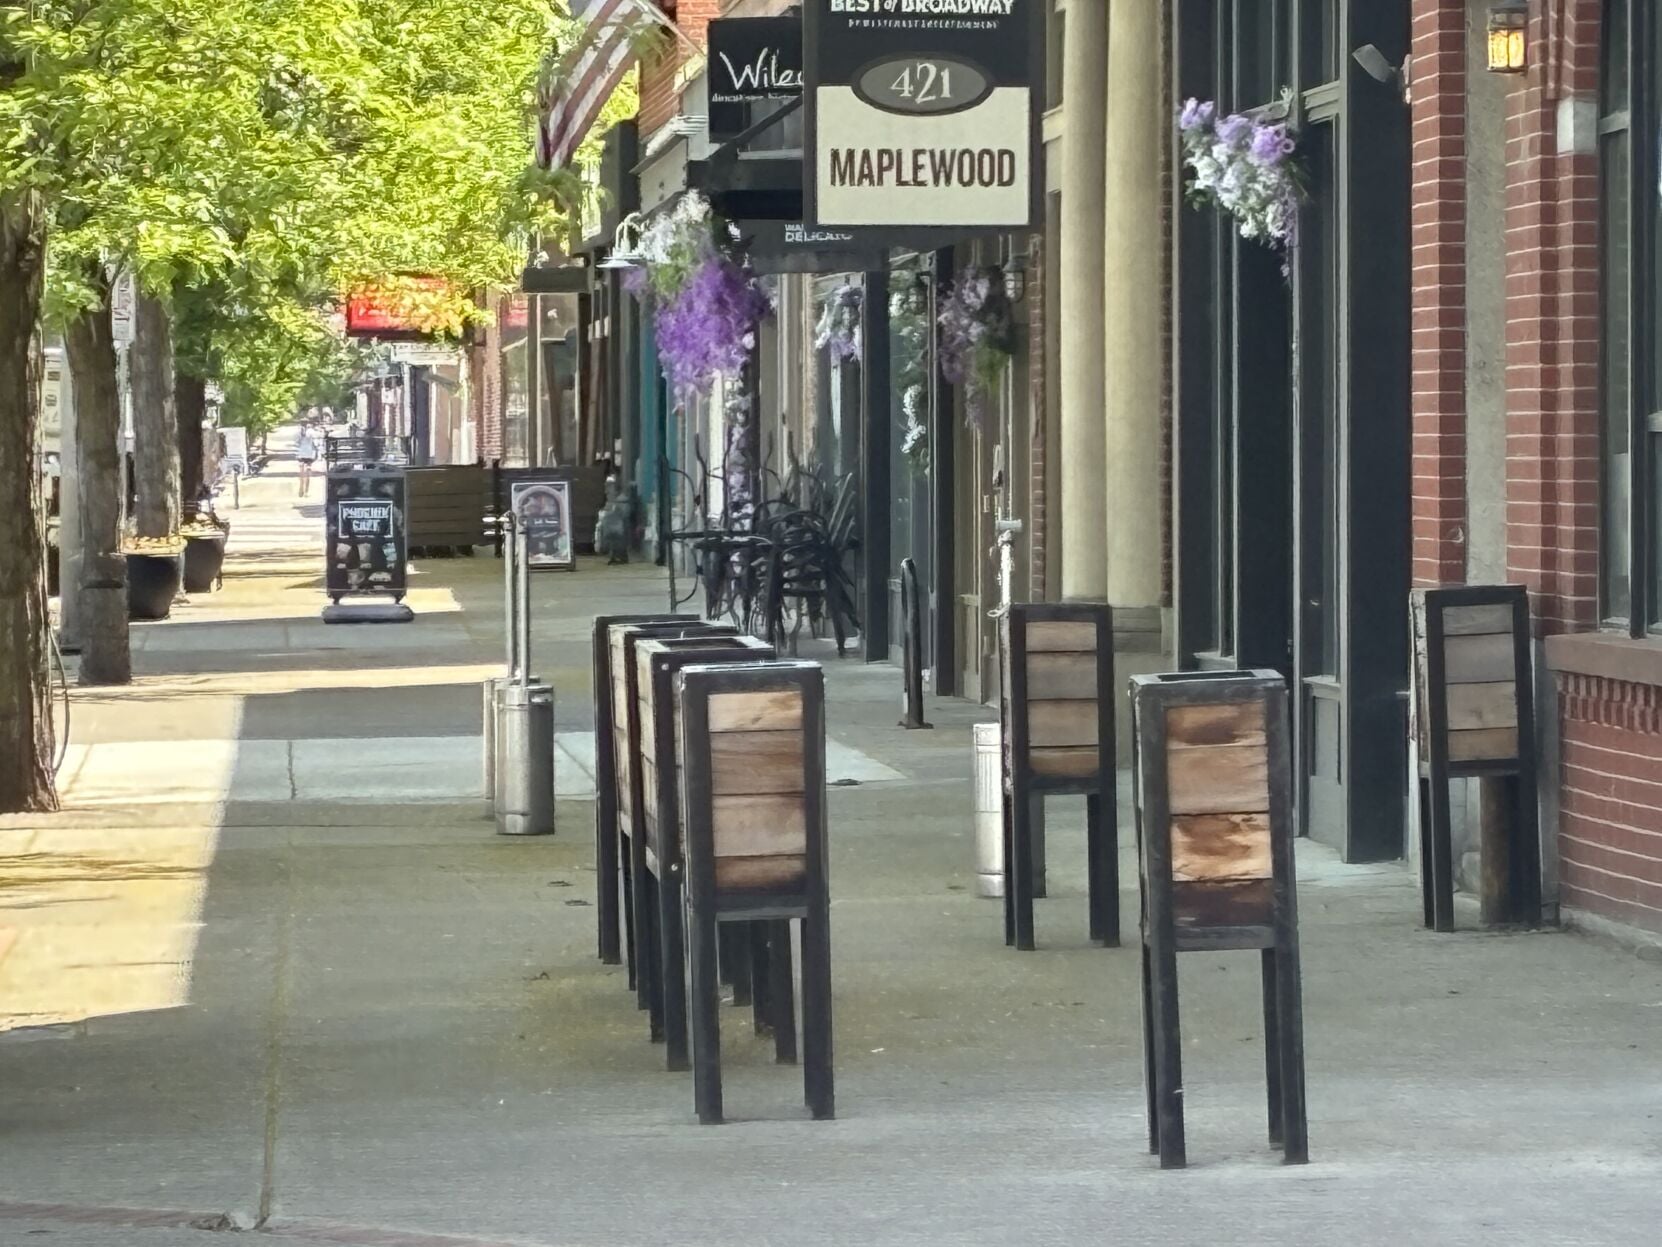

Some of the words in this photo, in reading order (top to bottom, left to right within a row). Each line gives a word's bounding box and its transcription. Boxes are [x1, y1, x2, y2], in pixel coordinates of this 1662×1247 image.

[830, 0, 881, 12] BEST
[901, 0, 1013, 14] BROADWAY
[889, 62, 952, 104] 421
[829, 148, 1016, 187] MAPLEWOOD
